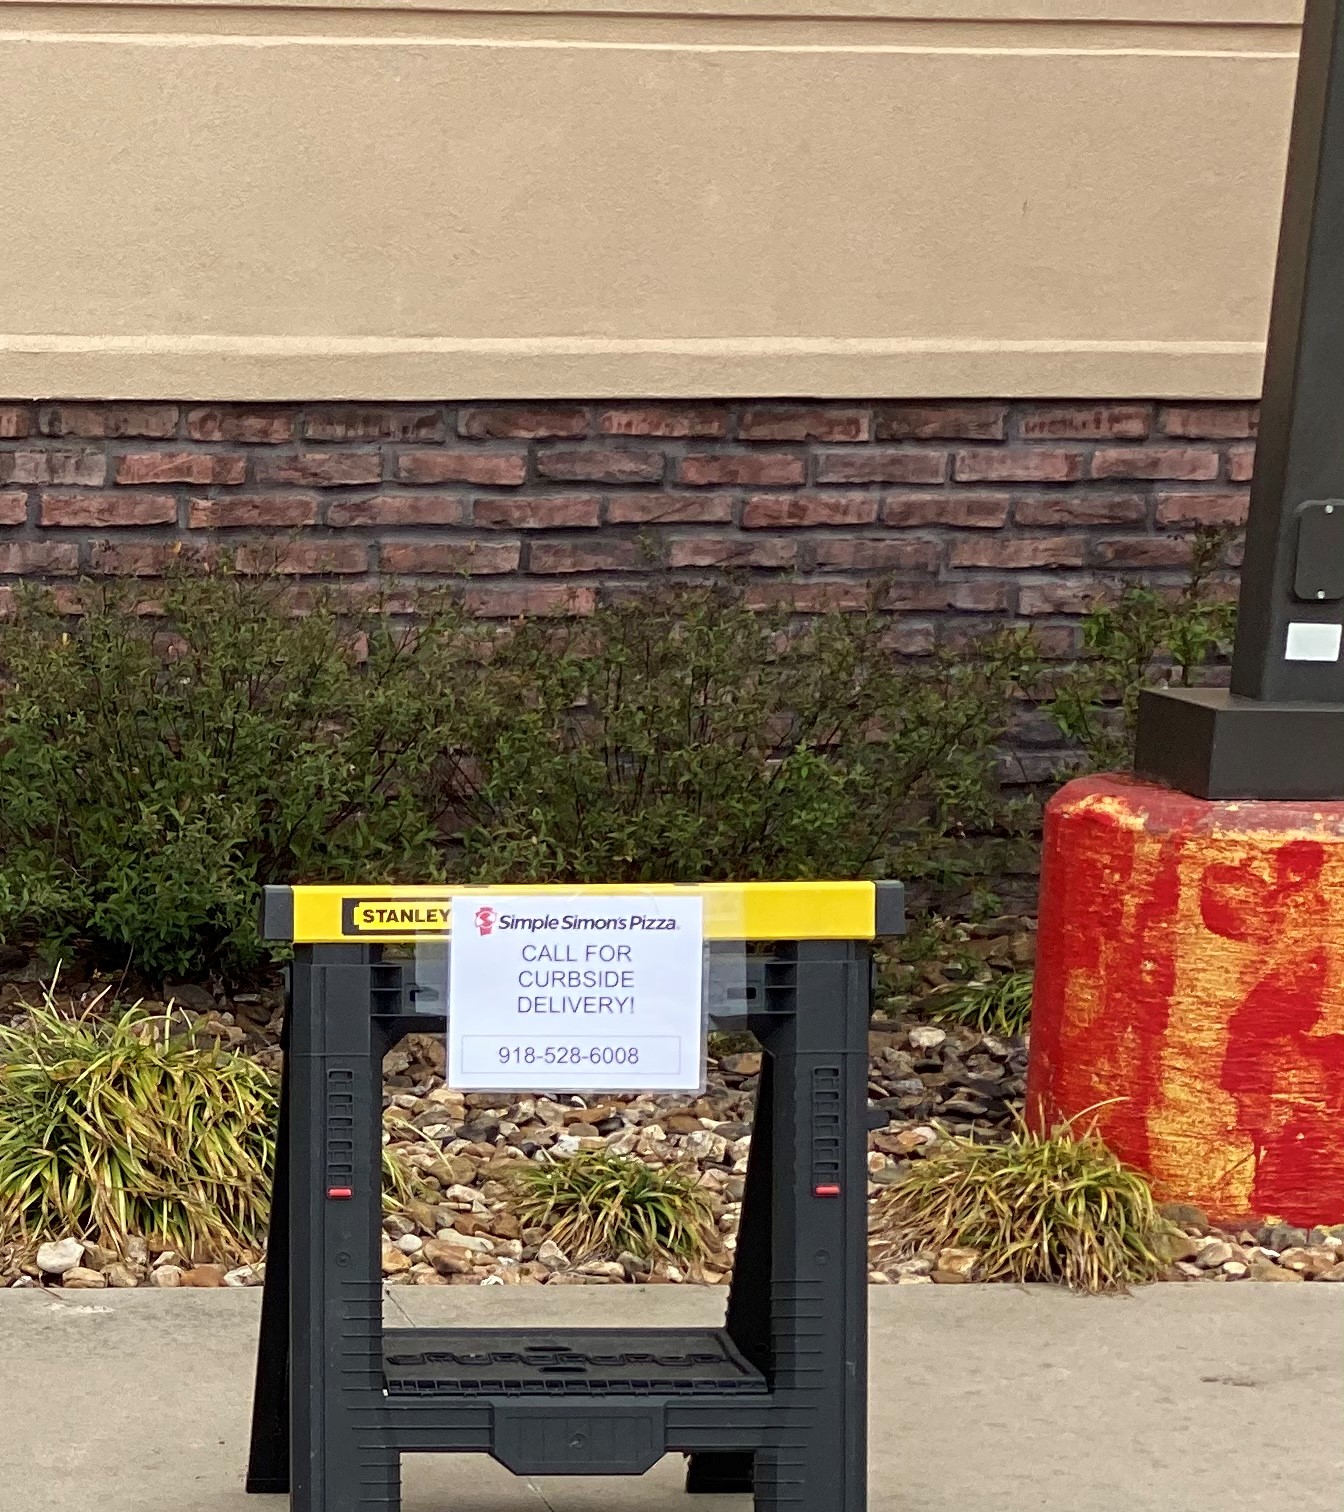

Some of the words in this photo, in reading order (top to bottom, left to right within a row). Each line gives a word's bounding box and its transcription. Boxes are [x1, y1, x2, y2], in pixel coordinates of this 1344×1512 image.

[362, 908, 451, 923] STANLEY
[498, 914, 560, 932] Simple
[561, 914, 628, 930] Simon's
[629, 915, 676, 930] Pizza
[521, 944, 578, 962] CALL
[585, 944, 632, 962] FOR
[518, 970, 635, 988] CURBSIDE
[517, 996, 635, 1014] DELIVERY!
[498, 1047, 639, 1064] 918-528-6008
